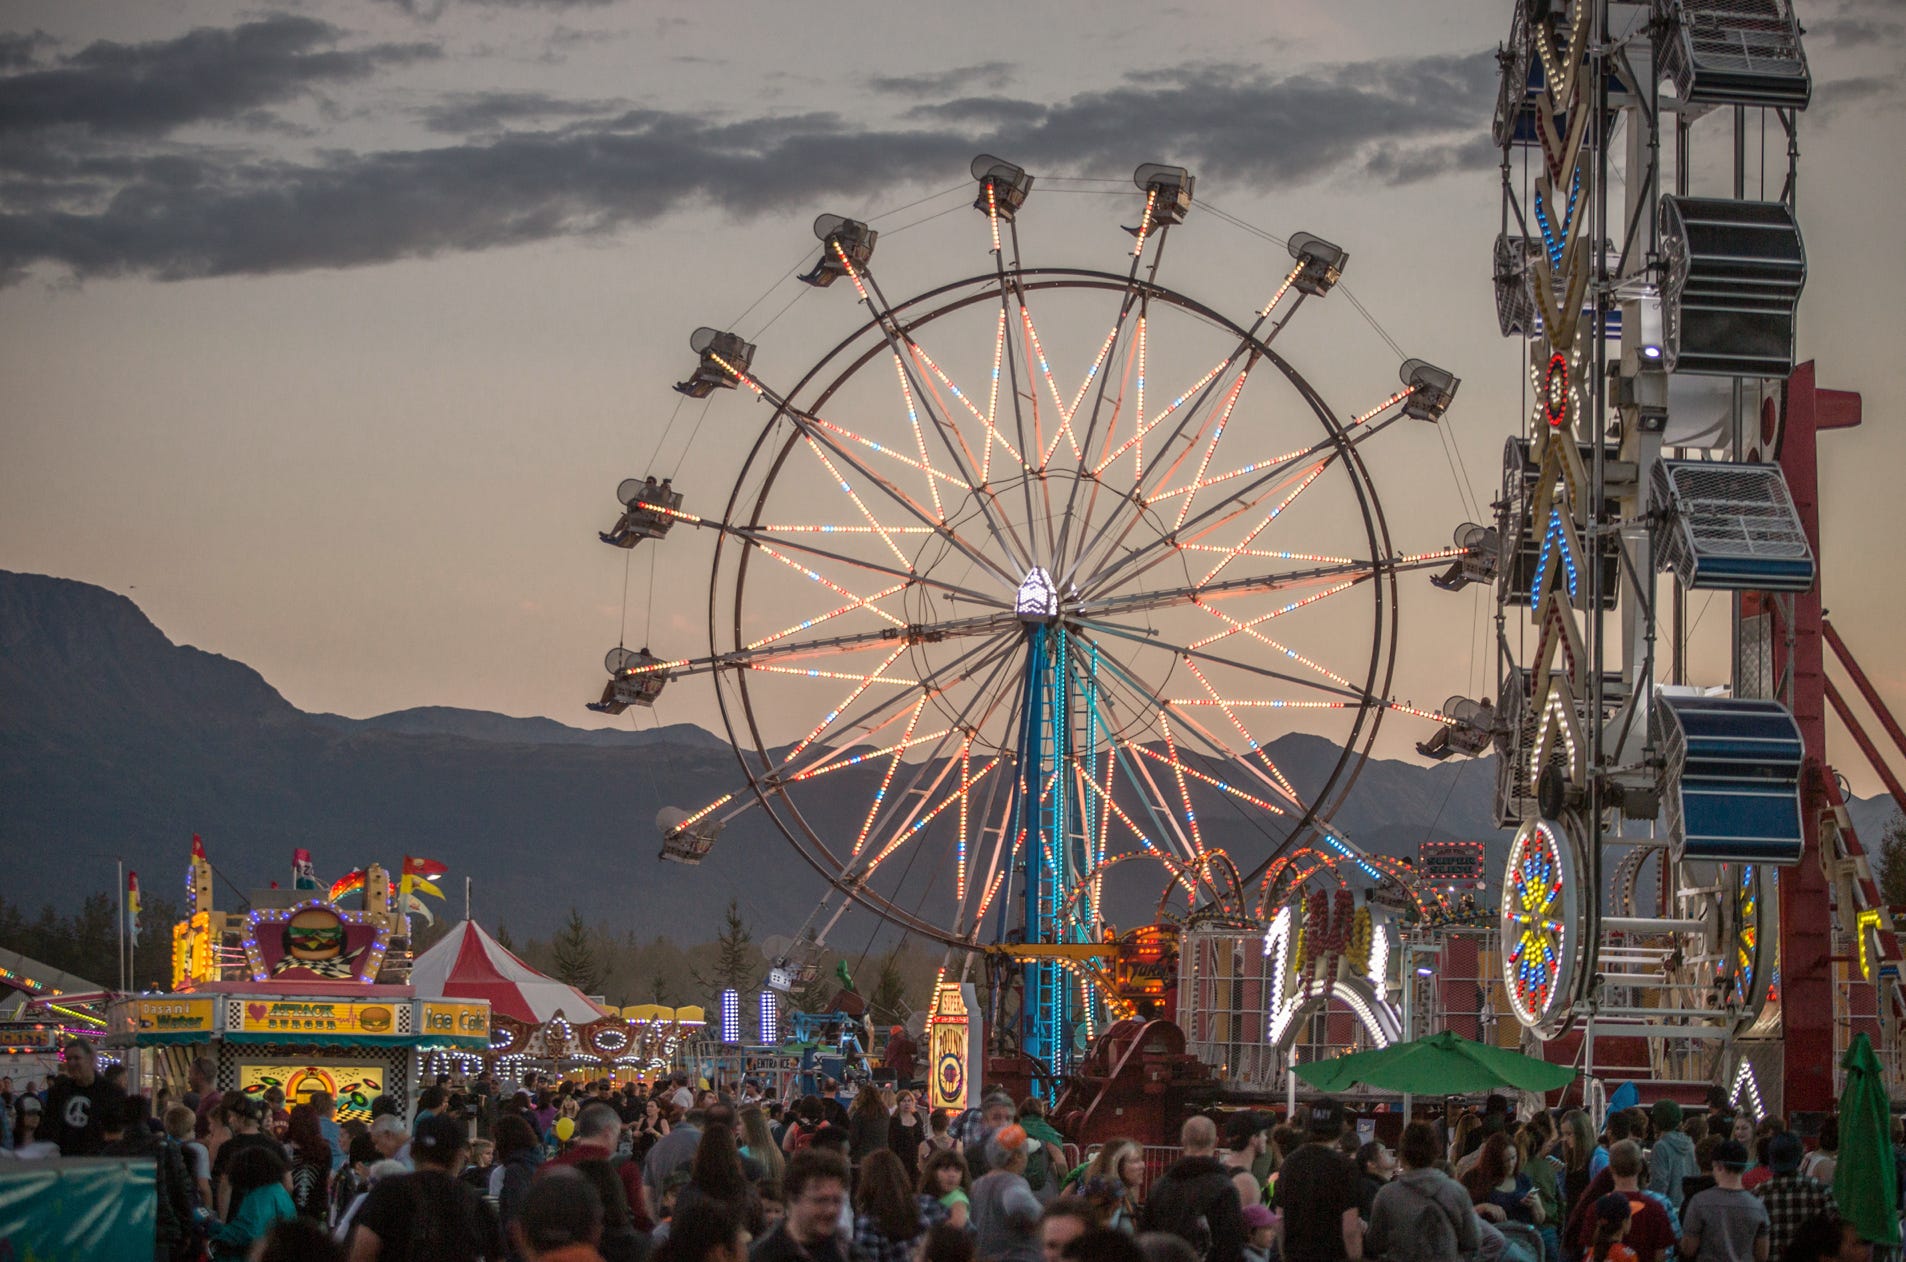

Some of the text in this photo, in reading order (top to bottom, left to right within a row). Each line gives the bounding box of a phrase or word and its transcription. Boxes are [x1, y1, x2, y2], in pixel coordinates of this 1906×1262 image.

[143, 1003, 190, 1014] Dasani
[943, 994, 961, 1011] SUPER
[269, 1004, 335, 1017] ATTACK
[157, 1015, 204, 1028] Water
[268, 1019, 336, 1030] BURGER
[425, 1008, 452, 1029] Ice
